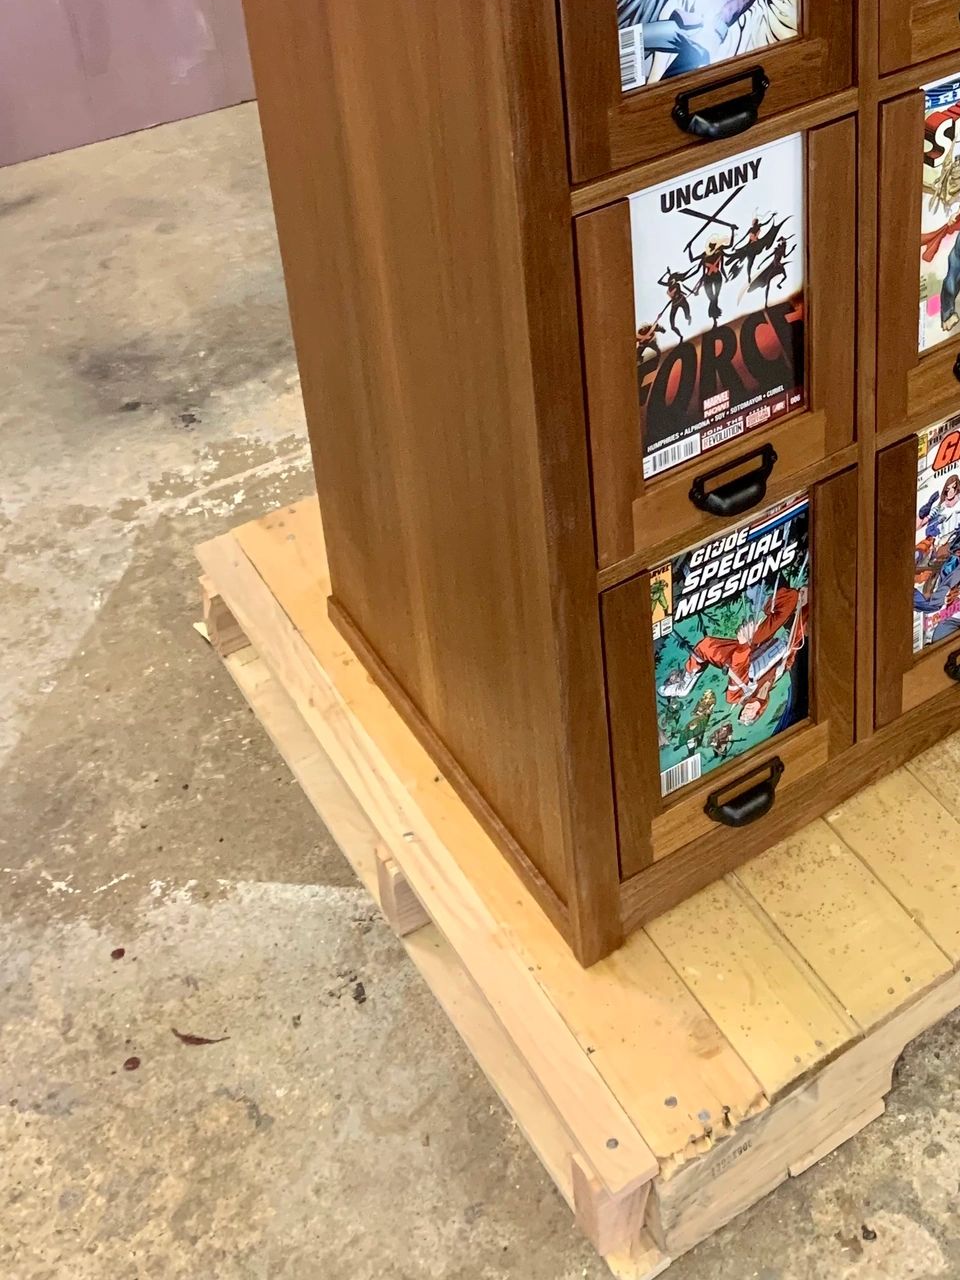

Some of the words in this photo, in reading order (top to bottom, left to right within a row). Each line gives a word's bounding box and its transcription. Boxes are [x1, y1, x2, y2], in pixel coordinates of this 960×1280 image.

[660, 157, 762, 213] UNCANNY
[702, 426, 723, 438] JOIN
[726, 415, 744, 426] THE
[702, 423, 744, 449] REVOLUTION
[674, 541, 798, 621] MISSIONS
[682, 528, 783, 595] SPECIAL
